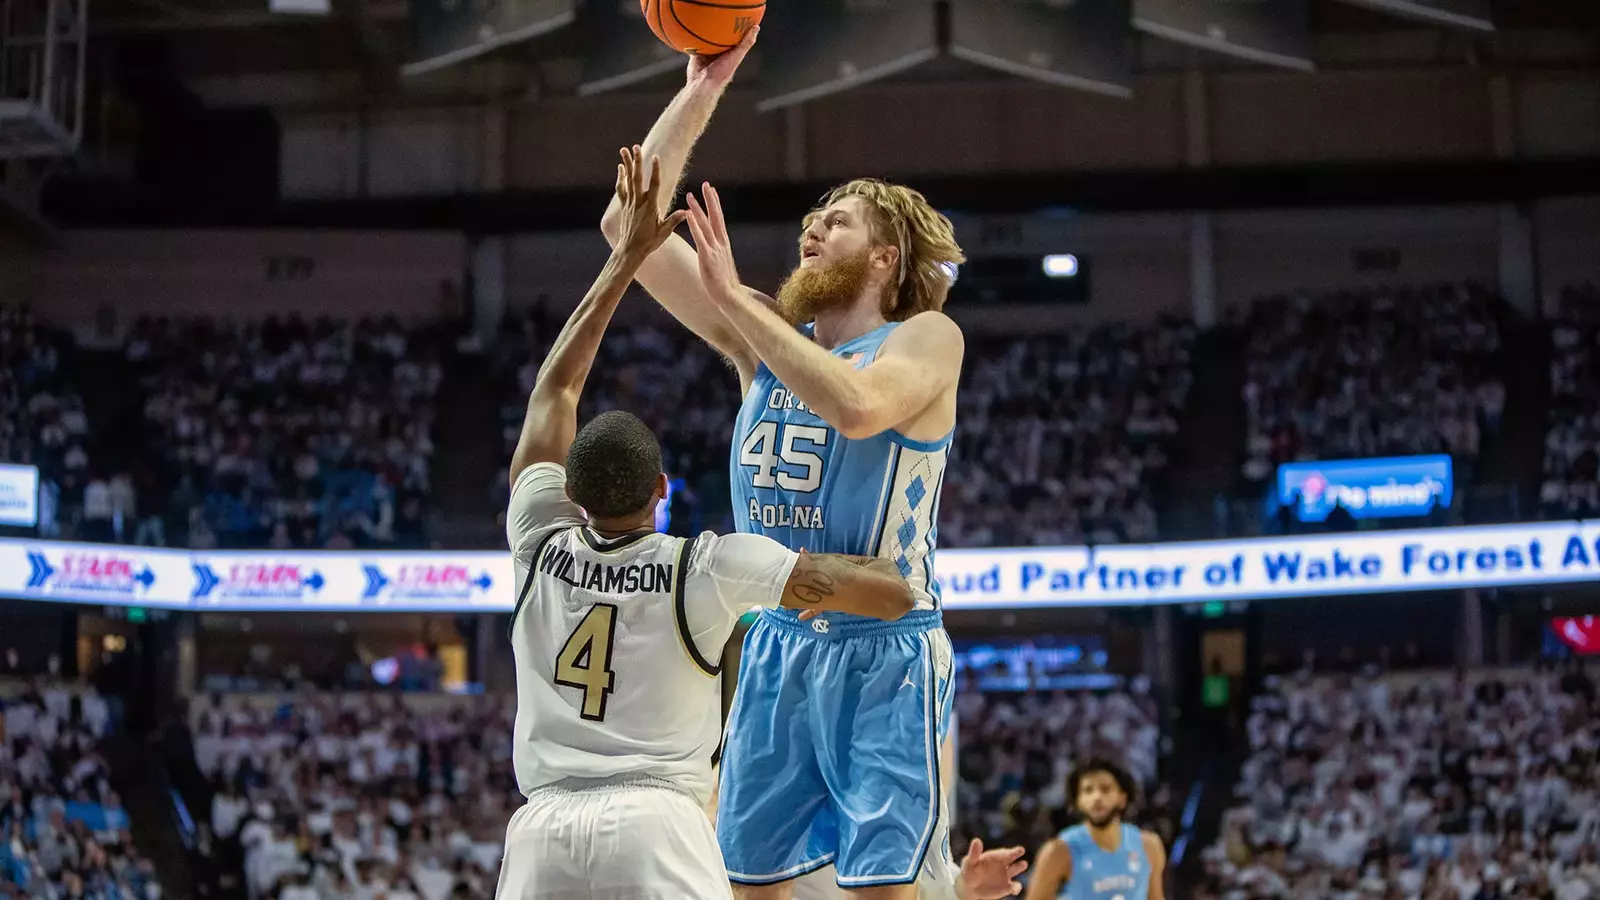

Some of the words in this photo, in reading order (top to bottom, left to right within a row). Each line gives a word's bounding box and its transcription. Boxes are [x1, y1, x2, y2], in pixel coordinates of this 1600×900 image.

[741, 421, 828, 493] 45
[1021, 561, 1186, 591] Partner
[1203, 554, 1244, 586] of
[1262, 549, 1382, 583] Wake
[1402, 539, 1542, 576] Forest
[554, 602, 618, 722] 4
